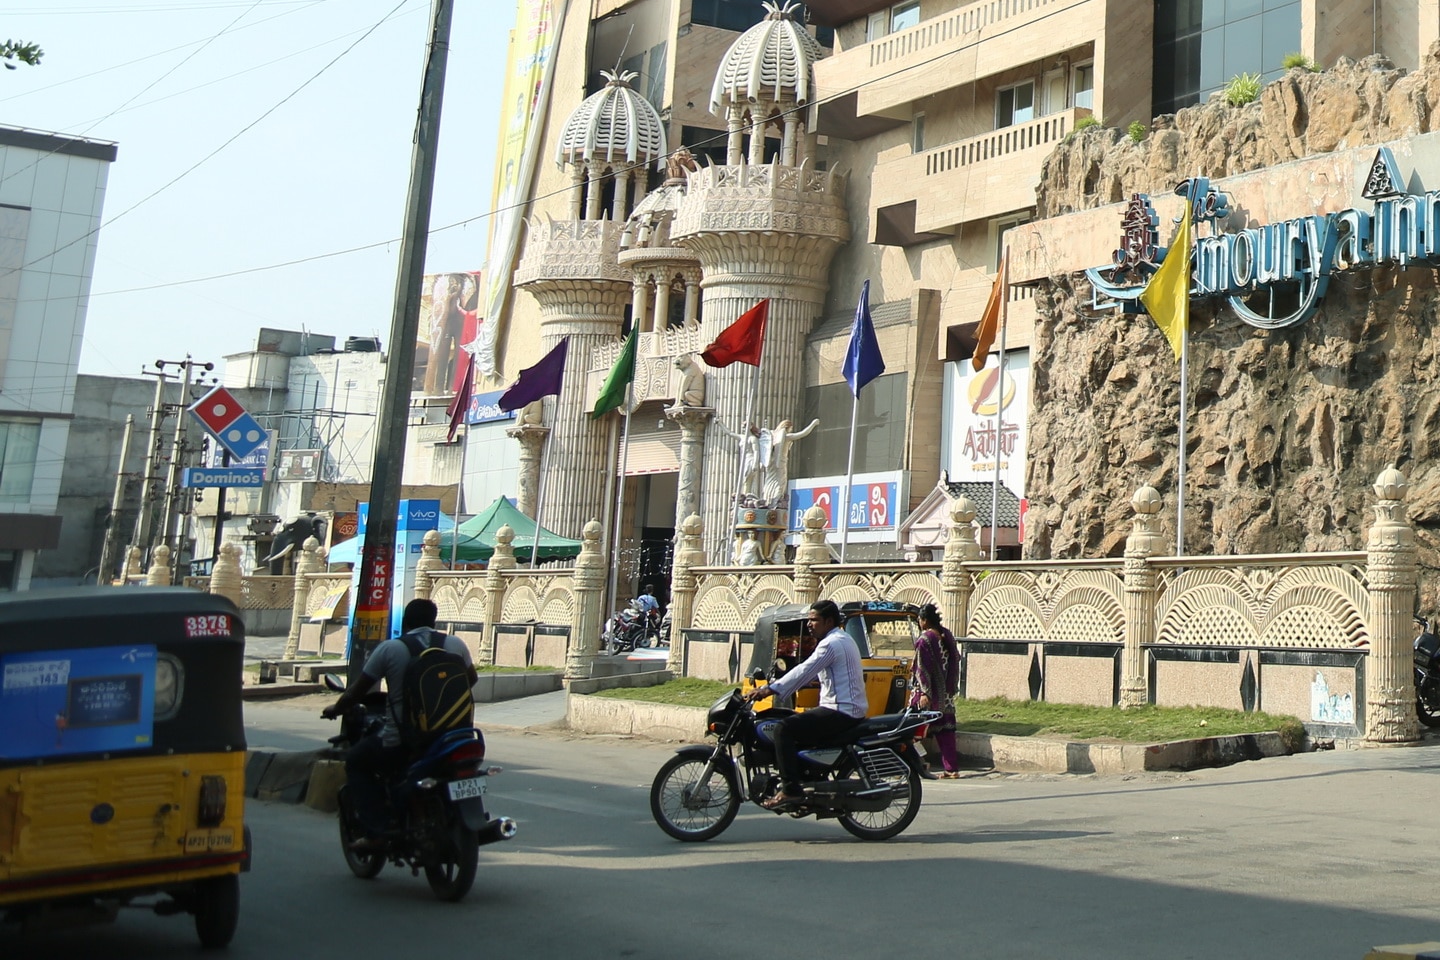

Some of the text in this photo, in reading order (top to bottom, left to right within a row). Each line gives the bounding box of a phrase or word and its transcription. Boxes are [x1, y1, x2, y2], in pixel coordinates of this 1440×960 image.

[192, 472, 260, 484] Domino's
[871, 486, 887, 526] సి
[409, 509, 436, 518] vivo
[187, 615, 227, 630] 3378
[457, 779, 478, 789] AP21
